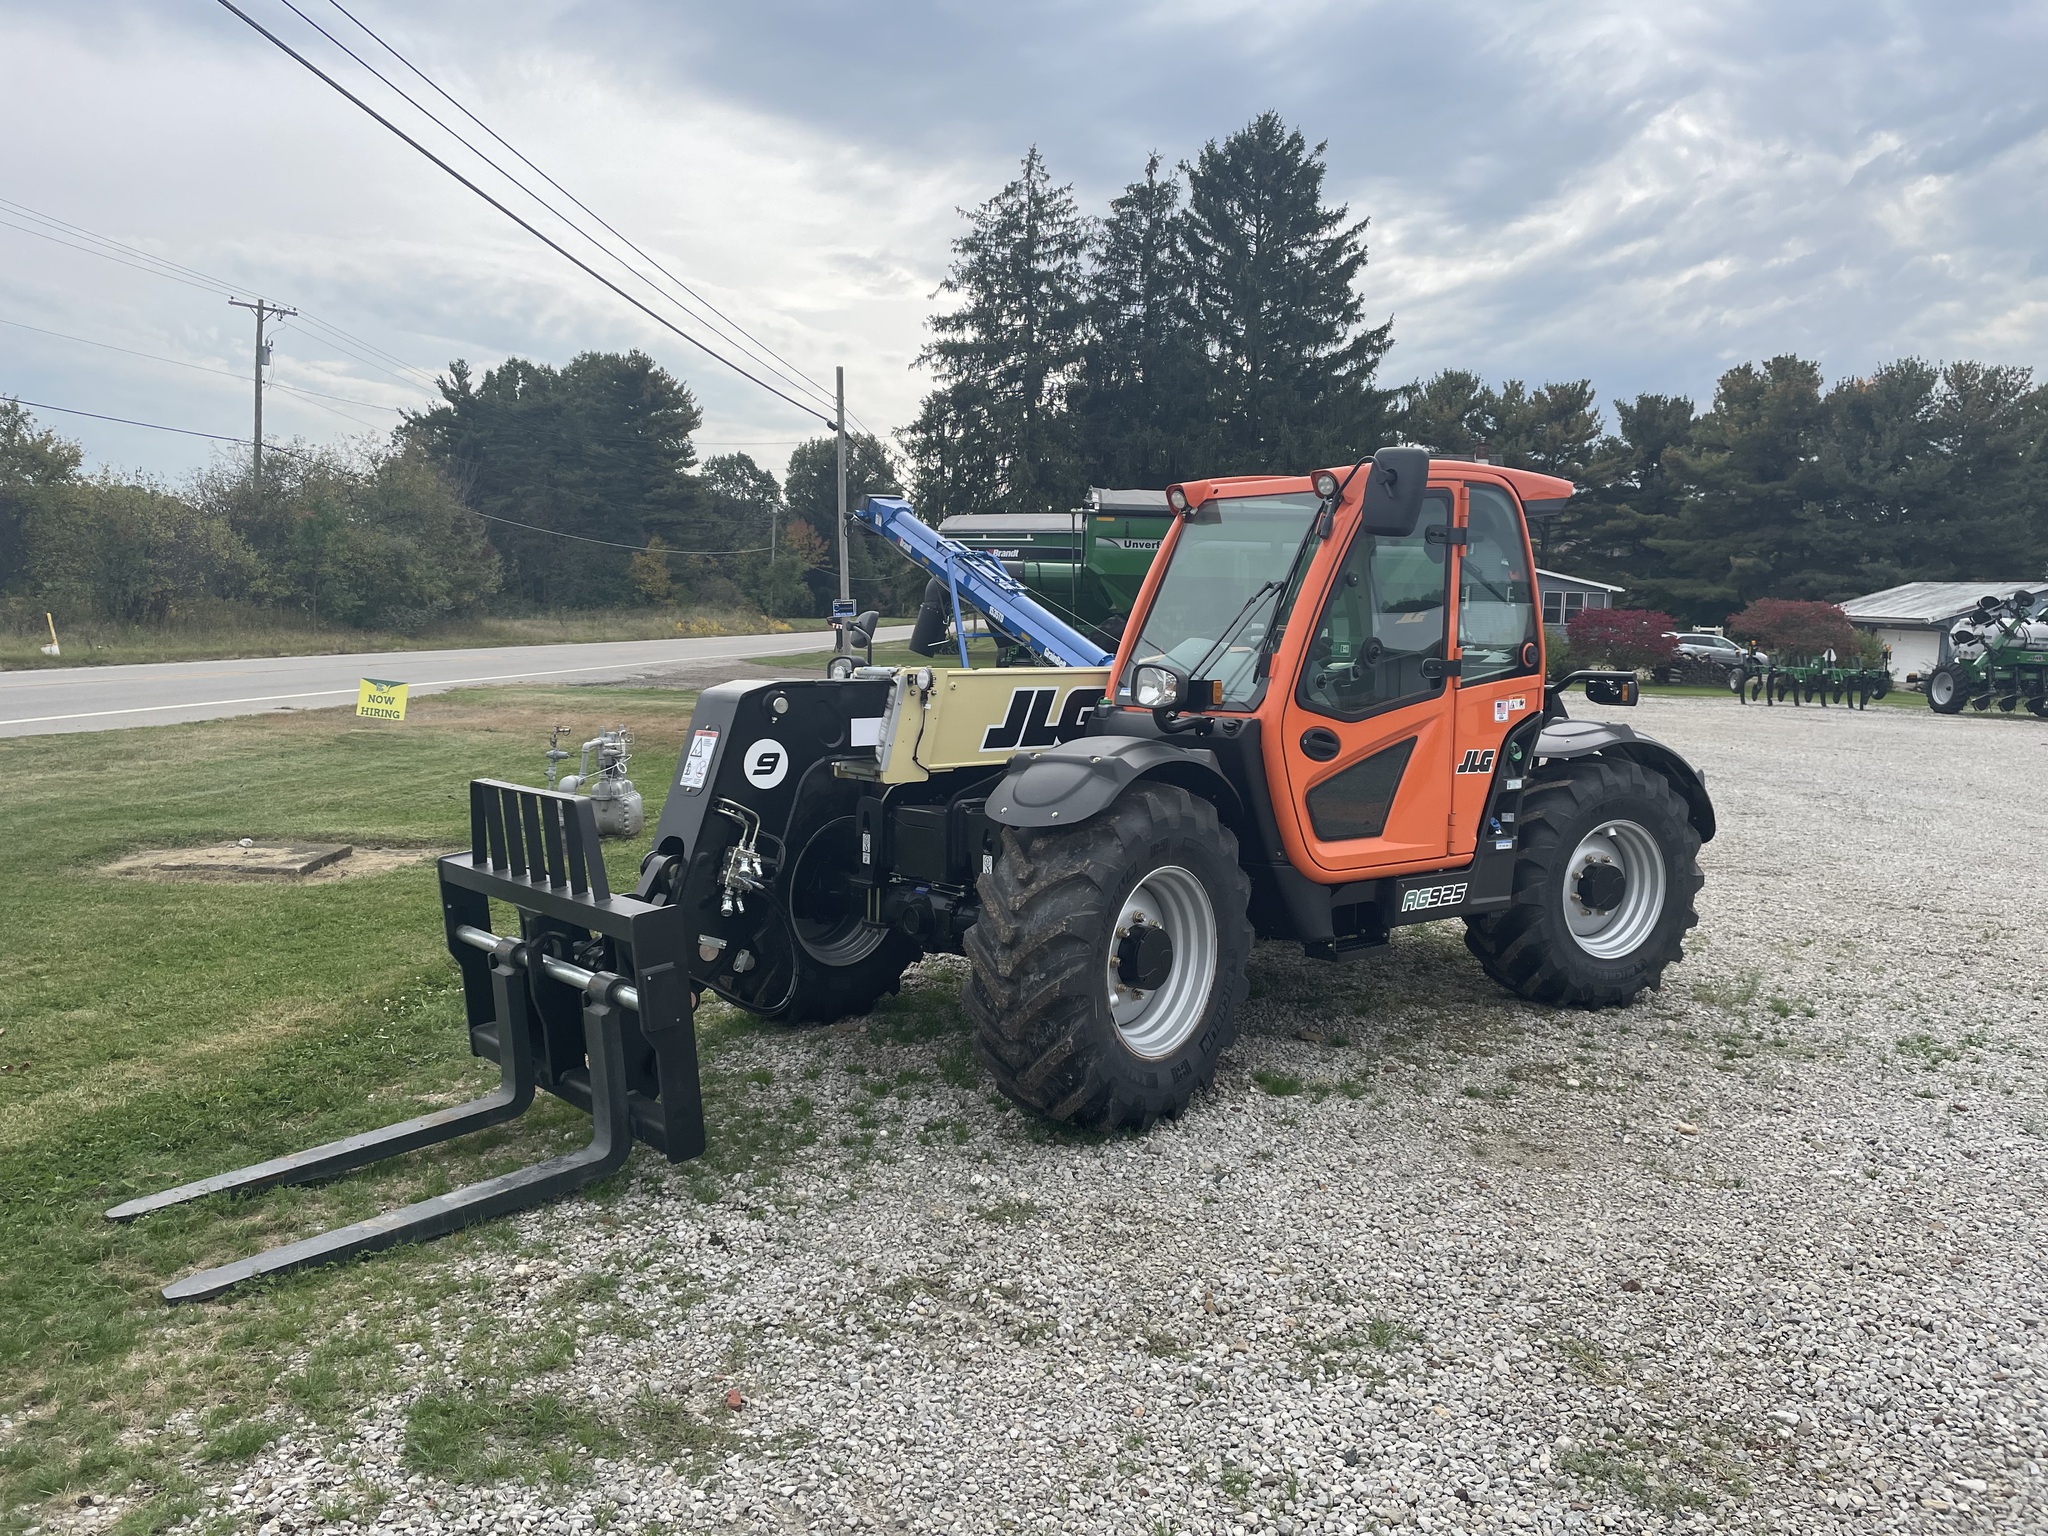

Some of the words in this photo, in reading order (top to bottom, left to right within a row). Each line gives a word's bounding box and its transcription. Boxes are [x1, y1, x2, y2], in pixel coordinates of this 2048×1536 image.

[993, 549, 1019, 558] Brandt
[368, 694, 395, 705] NOW
[361, 707, 400, 719] HIRING
[752, 753, 780, 775] 9
[1456, 749, 1496, 774] JLG
[1401, 883, 1468, 912] AG925
